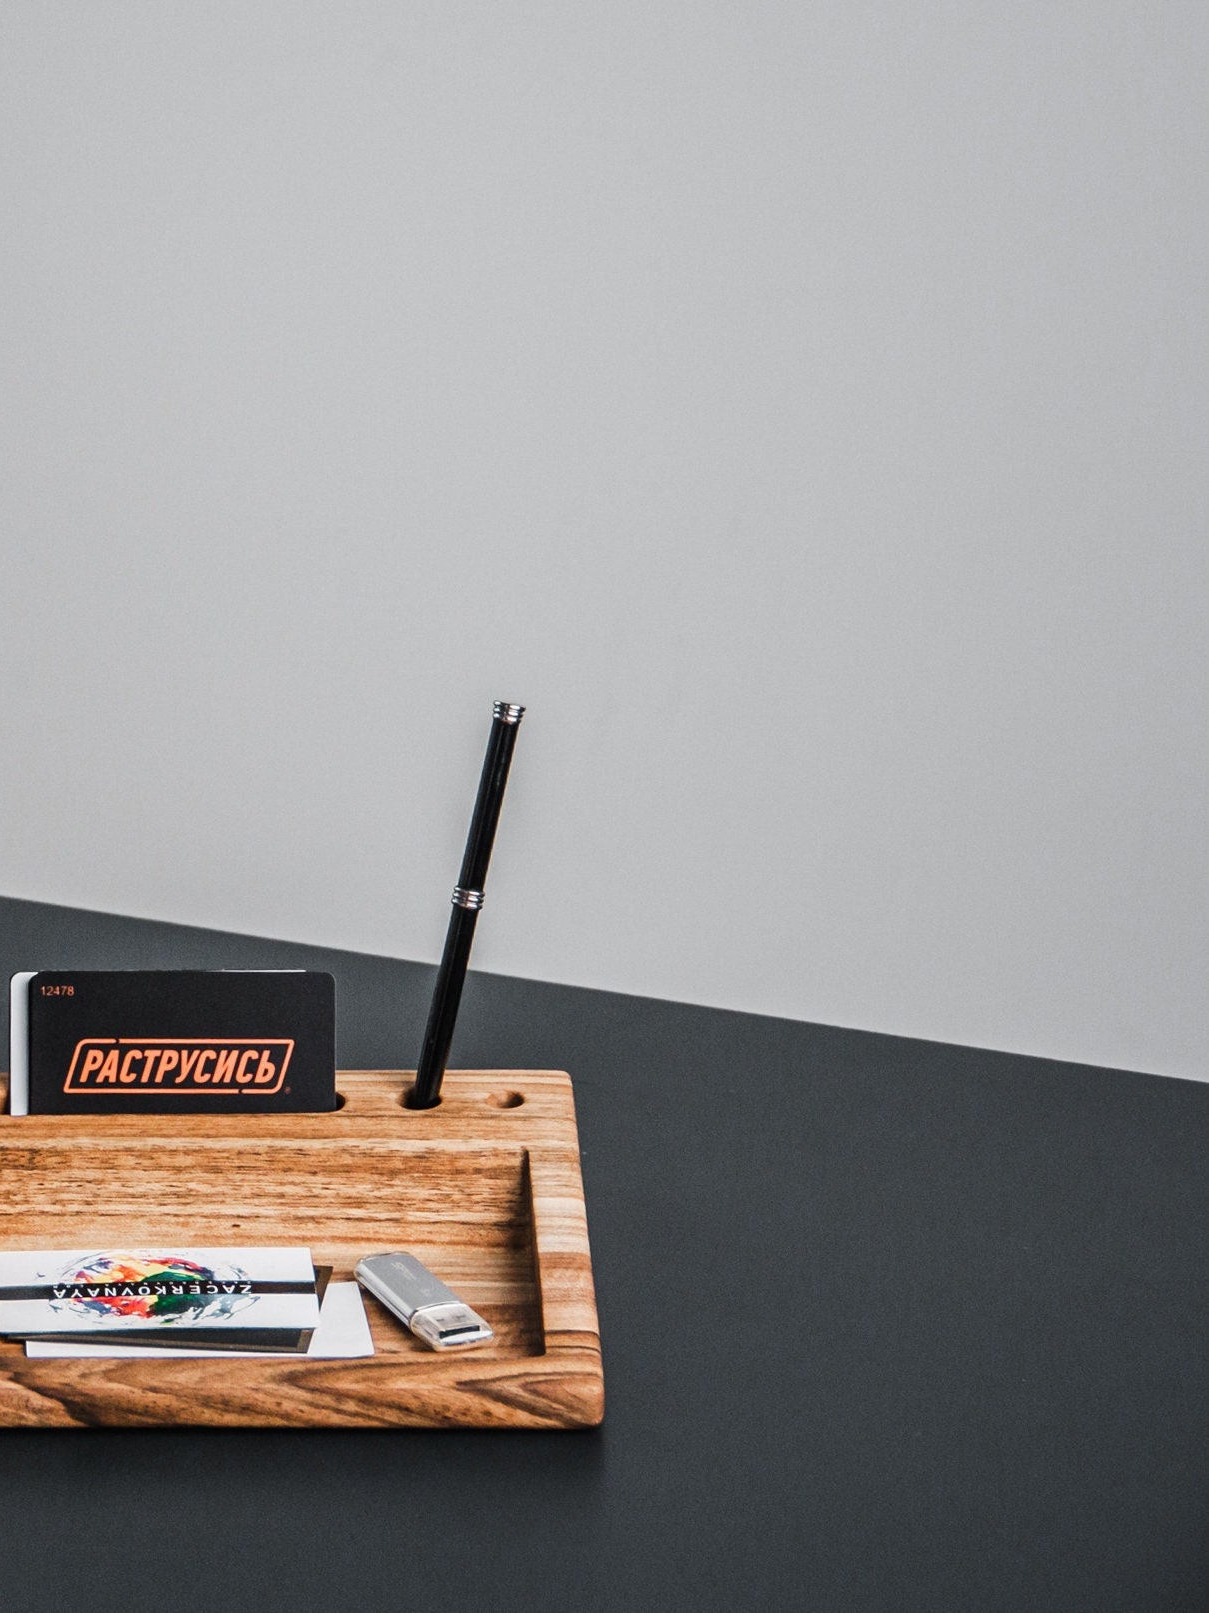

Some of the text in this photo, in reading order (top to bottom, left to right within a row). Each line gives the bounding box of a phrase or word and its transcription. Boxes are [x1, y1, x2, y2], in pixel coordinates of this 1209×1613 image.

[40, 985, 75, 997] 12478
[78, 1049, 277, 1084] РАСТРУСИСЬ
[53, 1284, 252, 1299] ZACERKOVNAYA
